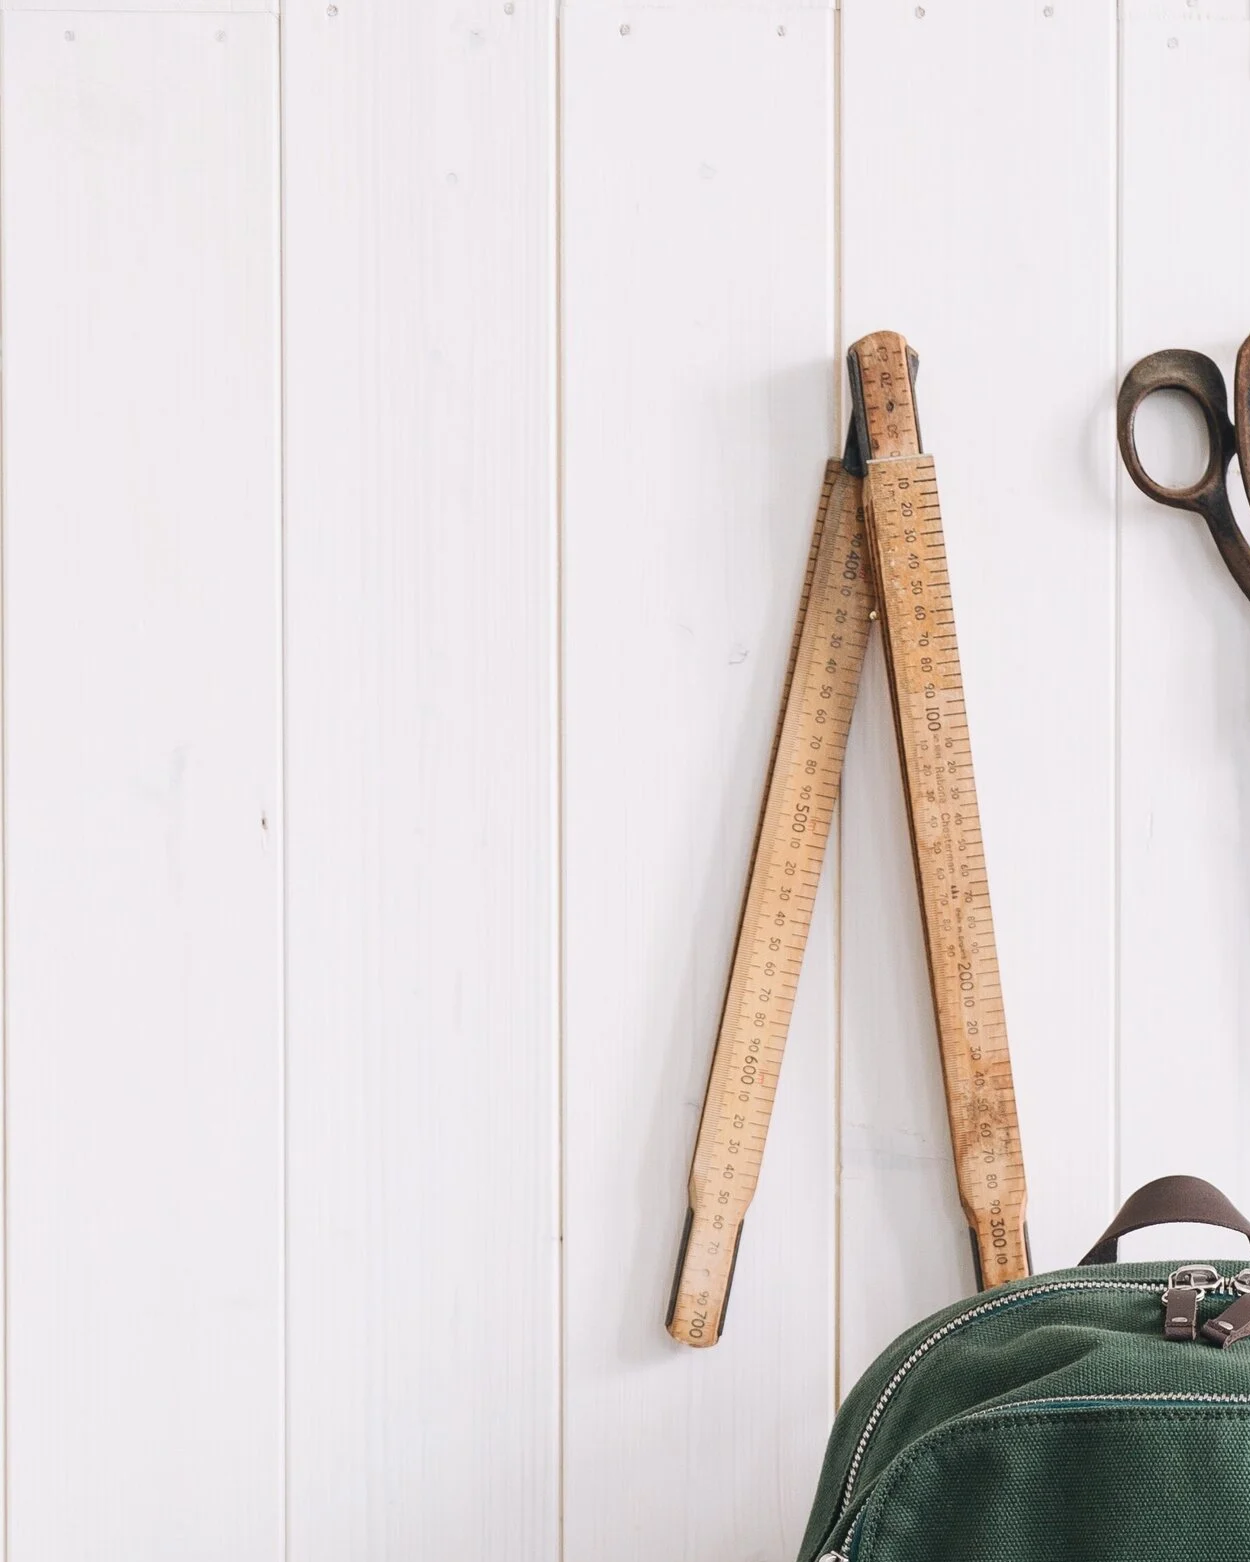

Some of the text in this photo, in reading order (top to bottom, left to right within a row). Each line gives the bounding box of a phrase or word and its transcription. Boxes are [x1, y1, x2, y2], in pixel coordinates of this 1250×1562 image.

[897, 477, 909, 489] 10
[900, 501, 913, 516] 20
[849, 532, 864, 548] 90
[904, 528, 916, 543] 30
[841, 549, 861, 580] 400
[906, 552, 919, 569] 40
[839, 584, 852, 597] 10
[910, 579, 923, 595] 50
[834, 608, 847, 623] 20
[913, 605, 926, 620] 60
[829, 633, 842, 648] 30
[917, 632, 929, 646] 70
[824, 658, 837, 673] 40
[920, 656, 933, 672] 80
[819, 684, 832, 699] 50
[923, 683, 935, 698] 90
[814, 708, 827, 724] 60
[925, 706, 941, 731] 100
[809, 733, 822, 749] 70
[803, 758, 817, 775] 80
[798, 783, 811, 800] 90
[934, 766, 949, 803] Rabone
[791, 803, 809, 833] 500
[789, 837, 801, 849] 10
[919, 739, 955, 957] 10 20 30 40 50 60 70 80 90
[940, 812, 958, 873] Chesterman
[943, 736, 979, 954] 10 20 30 40 50 60 70 80 90
[784, 861, 796, 876] 20
[778, 885, 791, 901] 30
[773, 910, 786, 926] 40
[767, 936, 780, 952] 50
[763, 961, 776, 976] 60
[758, 986, 771, 1002] 70
[752, 1011, 766, 1027] 80
[748, 1037, 761, 1052] 90
[739, 1055, 759, 1085] 600
[738, 1090, 750, 1102] 10
[732, 1114, 745, 1128] 20
[957, 961, 1008, 1265] 200 10 20 30 40 50 60 70 80 90 300 10
[727, 1138, 740, 1154] 30
[721, 1163, 735, 1179] 40
[716, 1189, 729, 1204] 50
[711, 1214, 724, 1229] 60
[688, 1309, 707, 1339] 700
